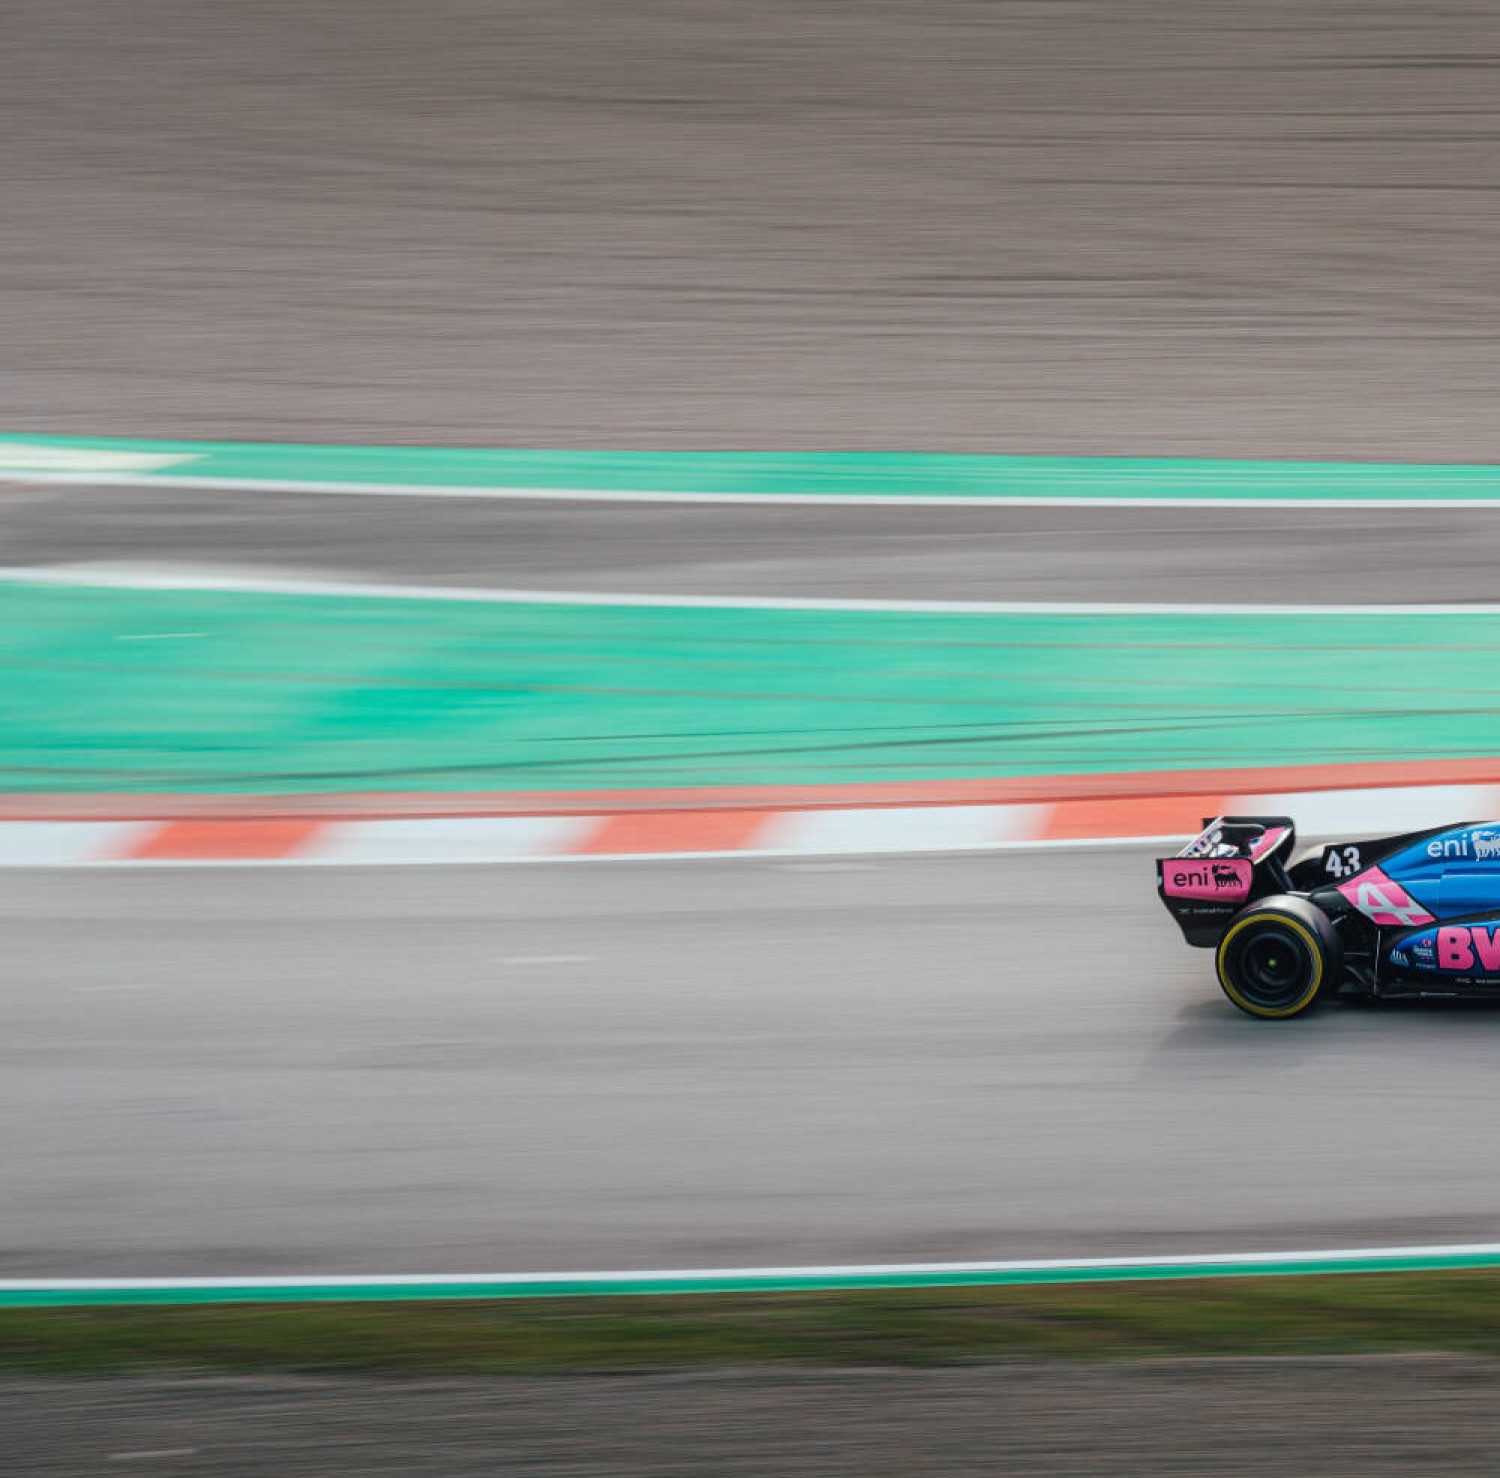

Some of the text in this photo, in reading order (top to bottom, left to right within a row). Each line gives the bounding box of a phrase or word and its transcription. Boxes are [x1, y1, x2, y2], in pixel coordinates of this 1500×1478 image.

[1427, 833, 1468, 857] eni
[1325, 846, 1361, 877] 43
[1173, 866, 1209, 887] eni
